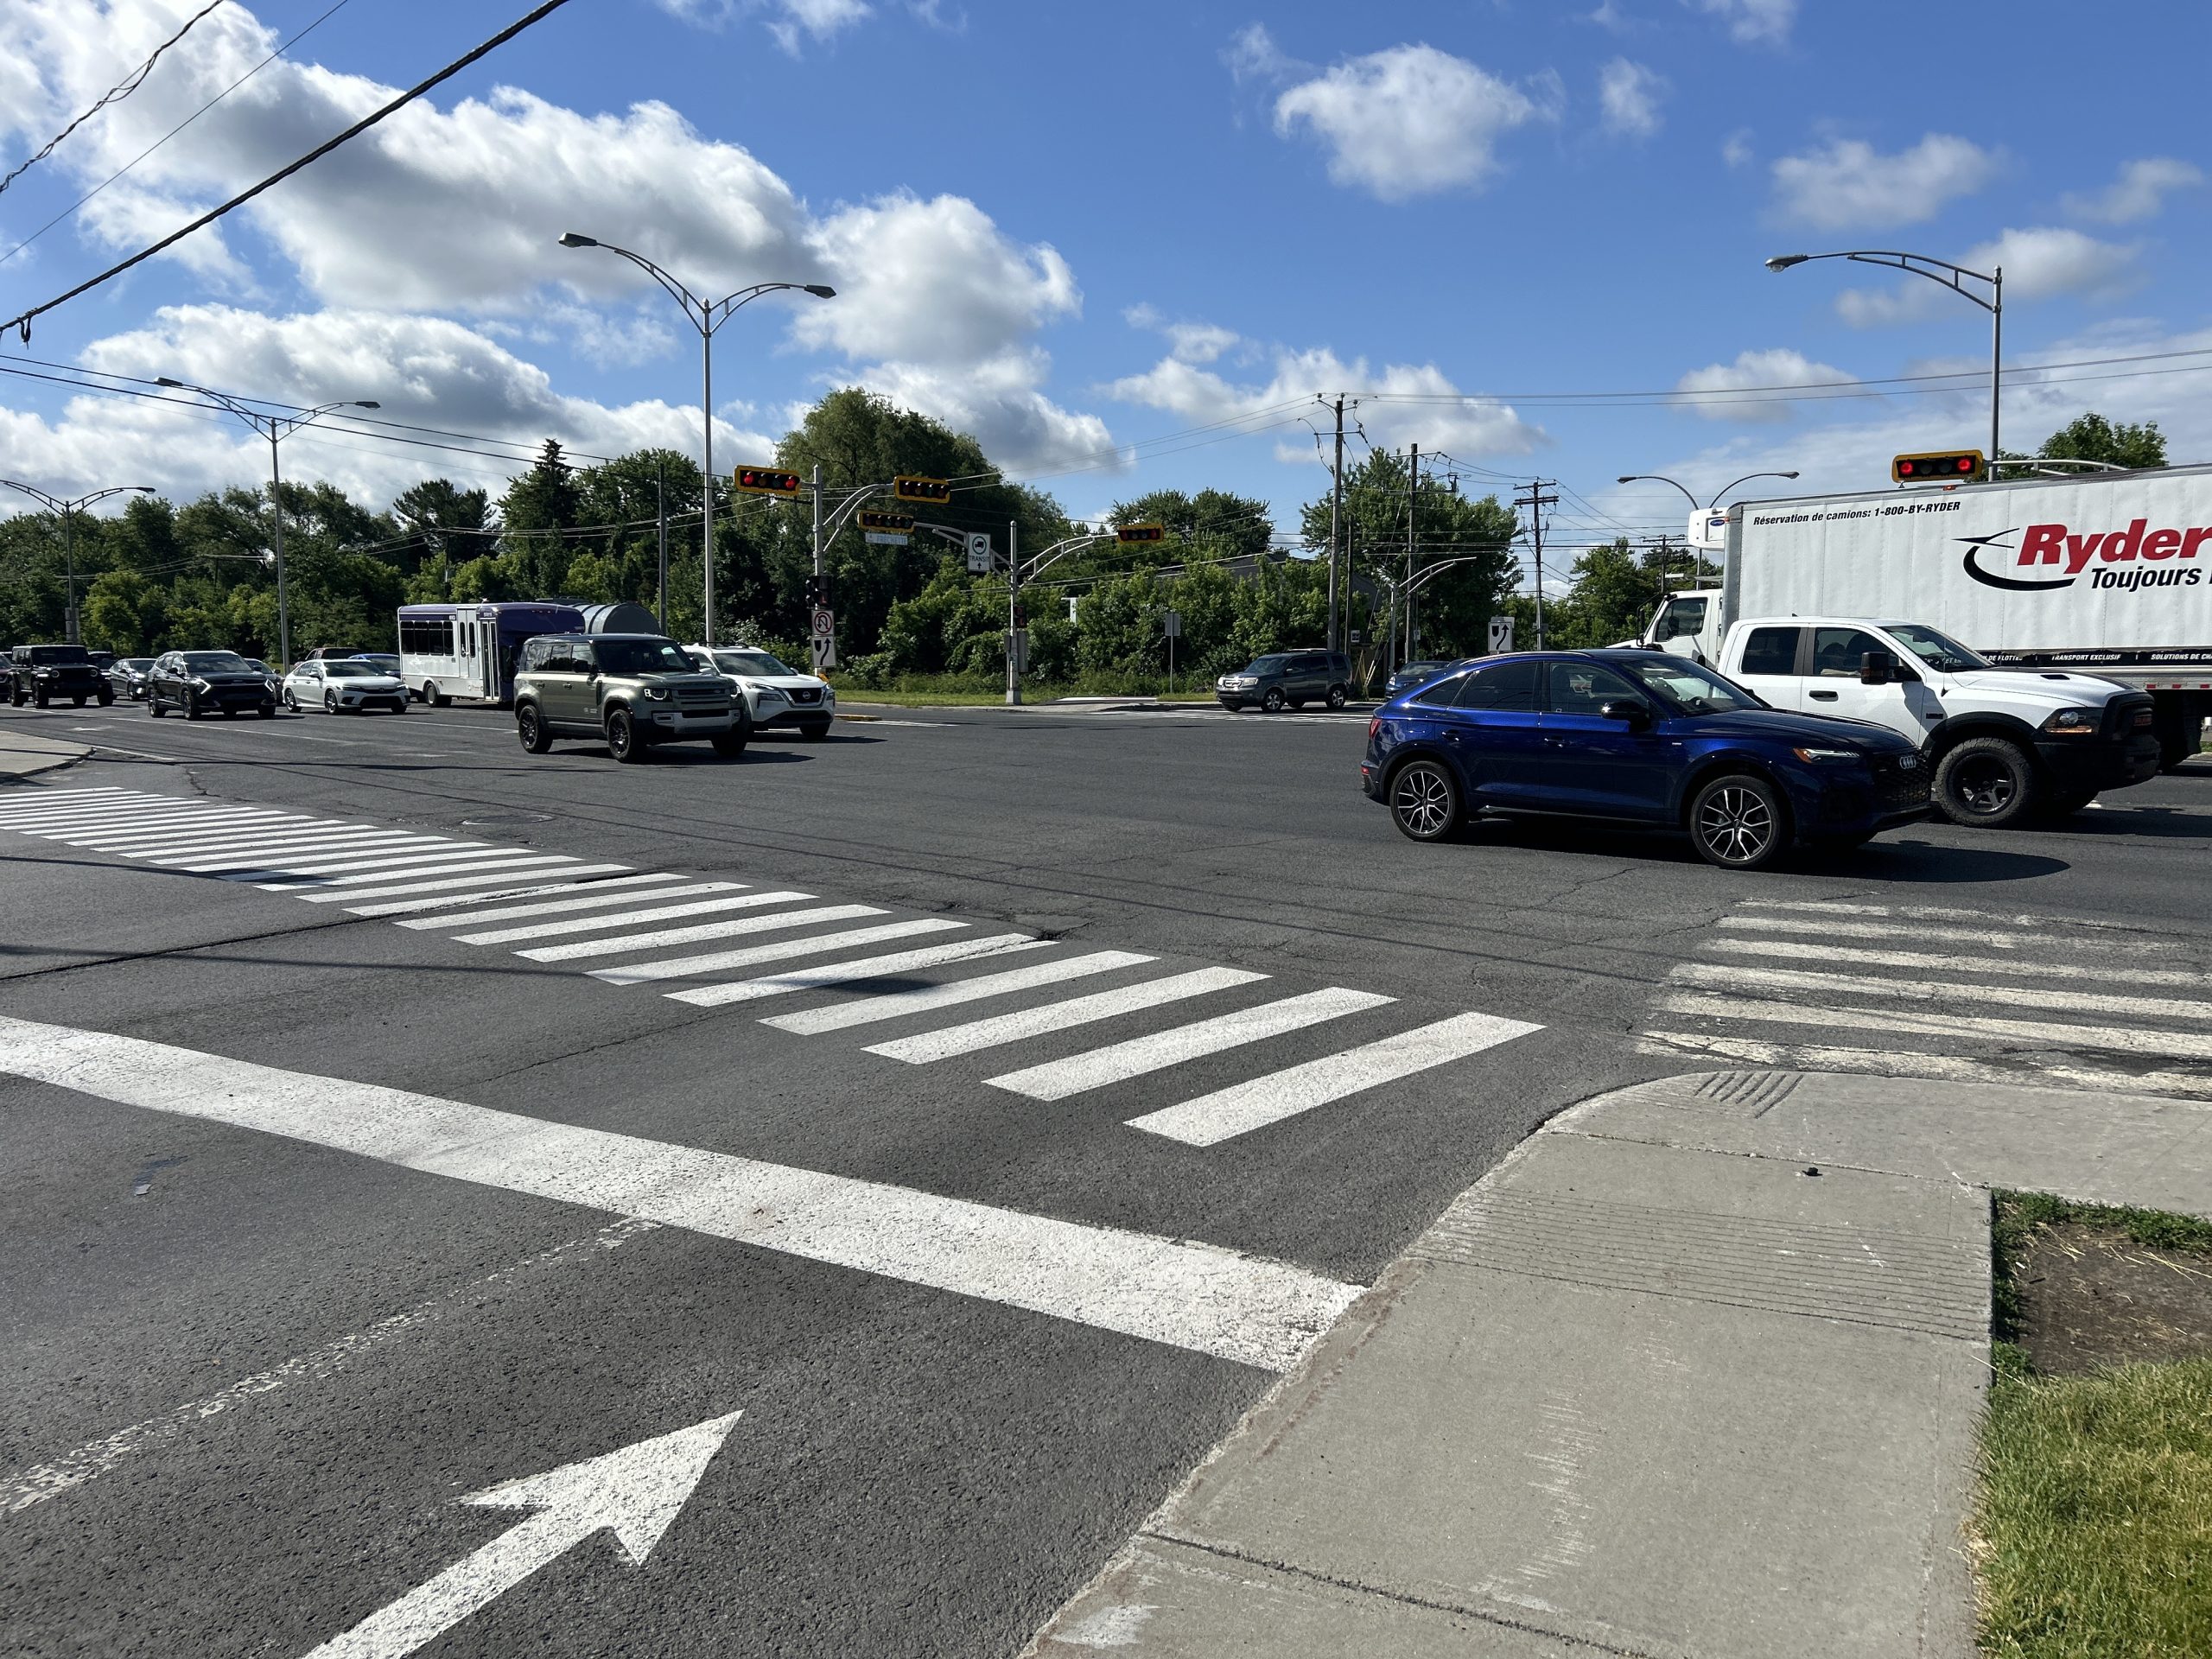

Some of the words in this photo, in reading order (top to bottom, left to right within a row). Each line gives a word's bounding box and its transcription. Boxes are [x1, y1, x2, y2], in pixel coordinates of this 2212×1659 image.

[1753, 513, 1808, 525] Réservation
[1811, 512, 1823, 521] de
[1826, 508, 1872, 520] camions:
[1874, 501, 1961, 517] 1-800-BY-RYDER
[2016, 518, 2212, 575] Ryder
[2091, 565, 2202, 593] Toujours
